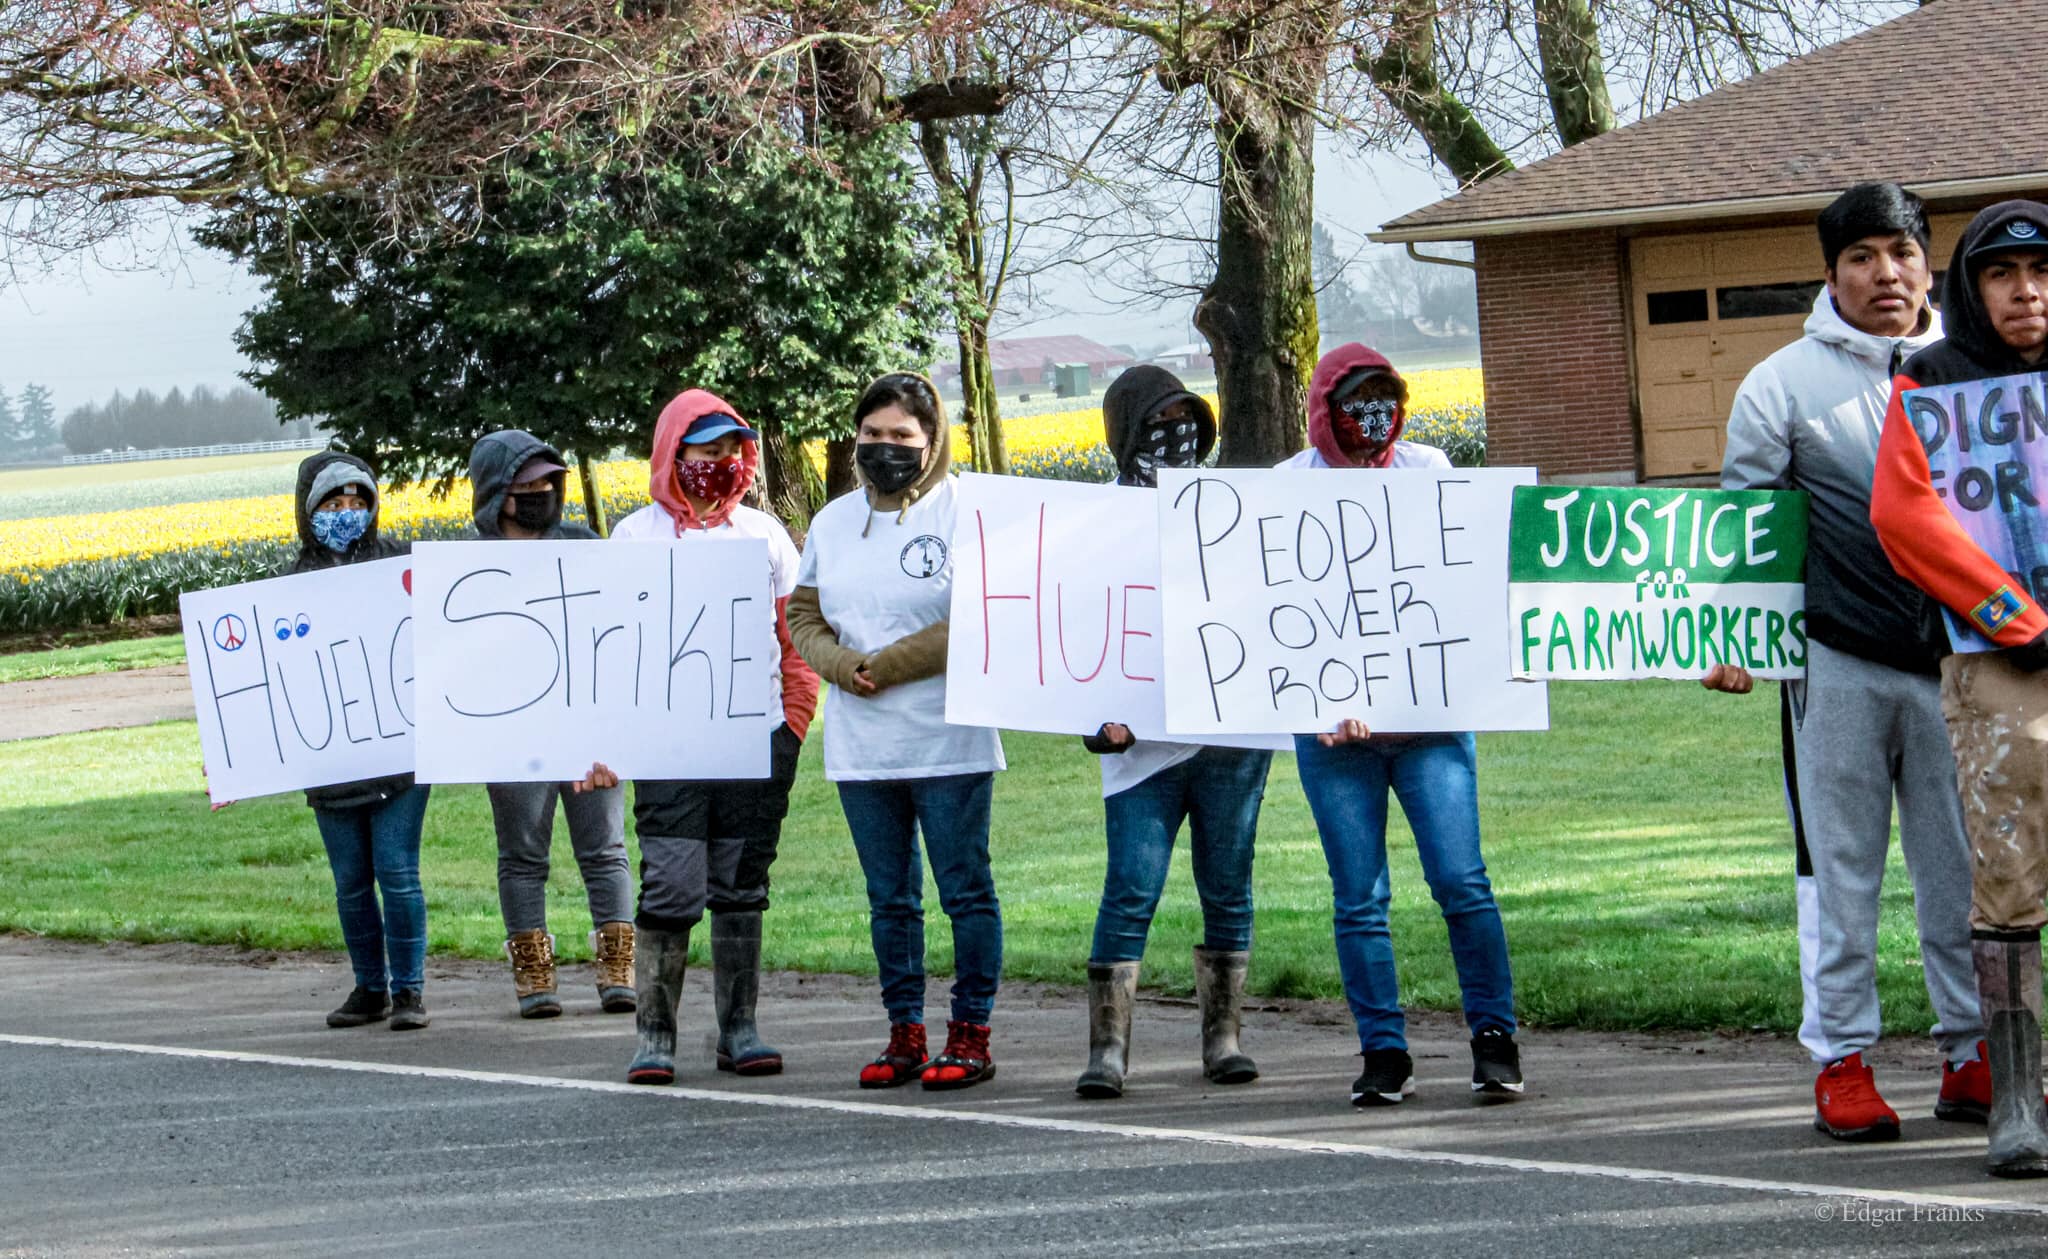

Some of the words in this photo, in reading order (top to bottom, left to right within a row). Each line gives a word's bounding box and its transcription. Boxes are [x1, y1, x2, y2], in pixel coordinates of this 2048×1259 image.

[1174, 477, 1473, 602] PEOPLE
[1539, 490, 1778, 568] JUSTICE
[976, 501, 1157, 686] HUE
[1269, 581, 1440, 650] OVER
[1635, 567, 1690, 603] FOR
[1198, 622, 1471, 723] PROFIT
[1521, 603, 1808, 676] FARMWORKERS
